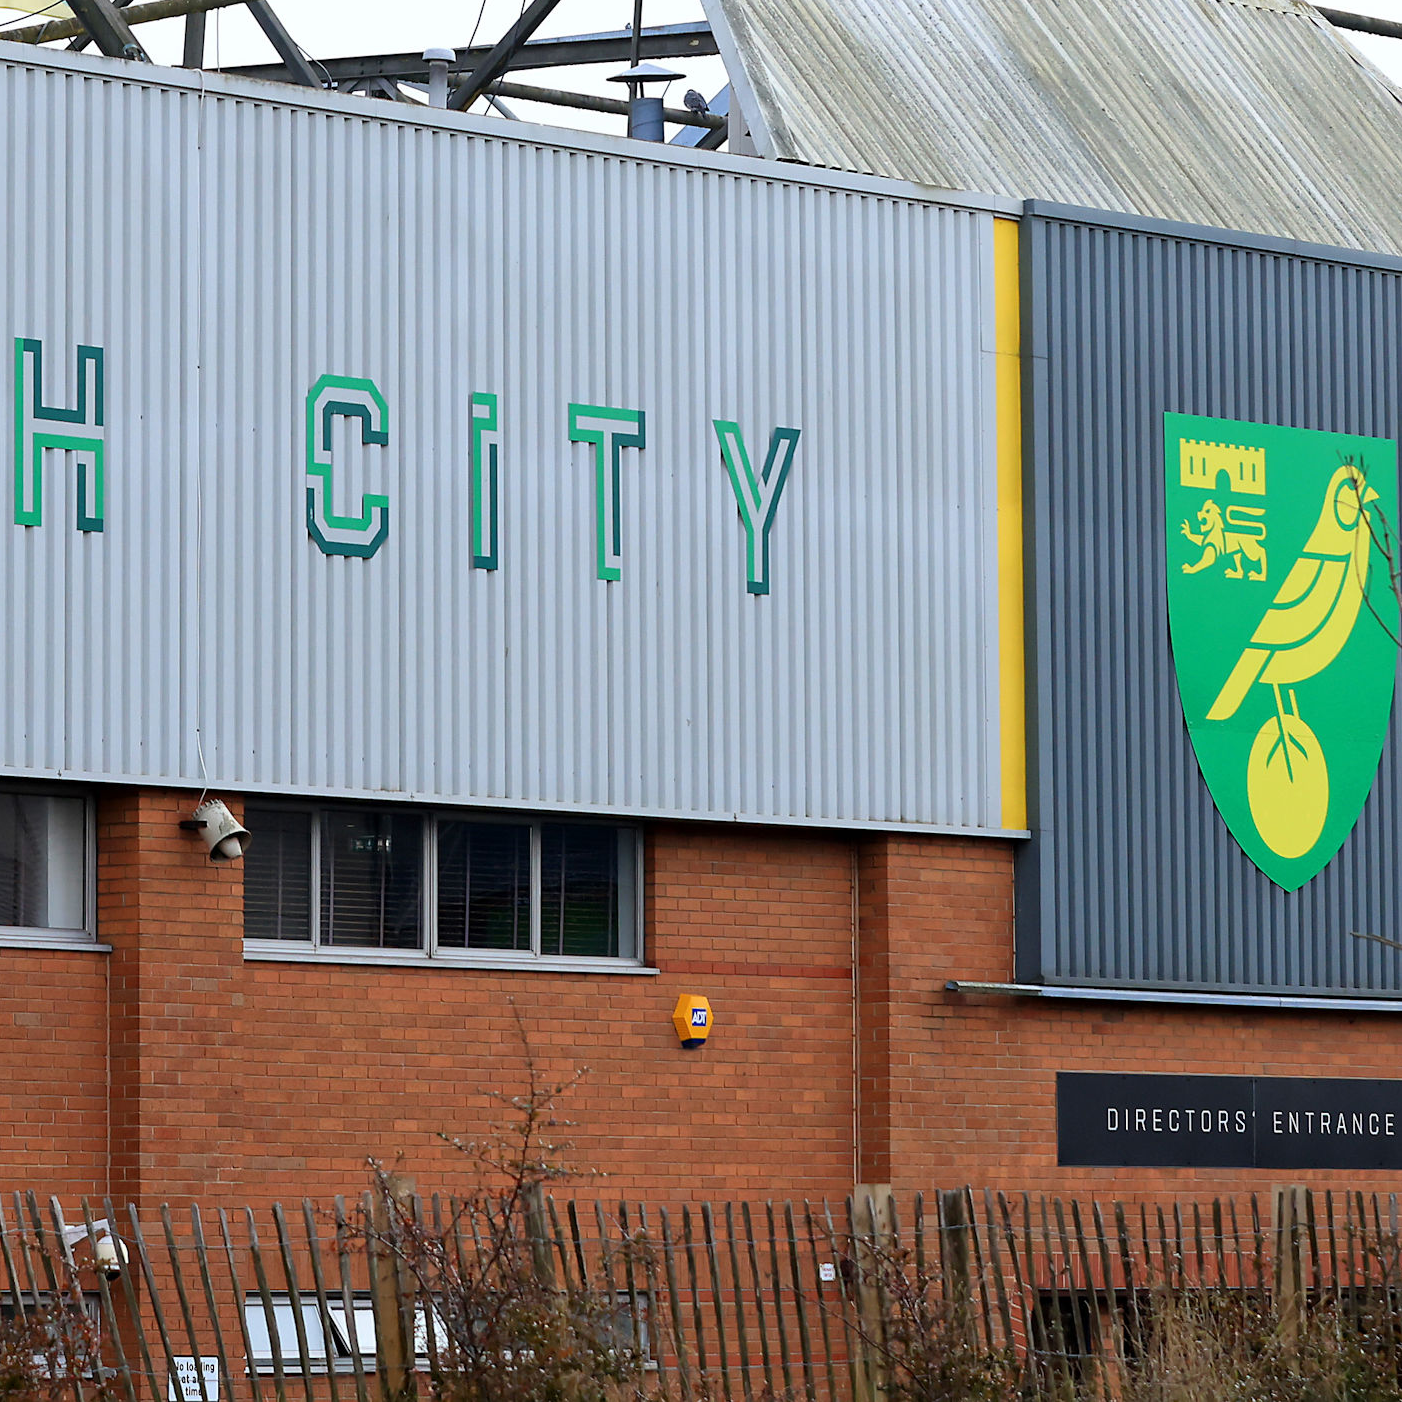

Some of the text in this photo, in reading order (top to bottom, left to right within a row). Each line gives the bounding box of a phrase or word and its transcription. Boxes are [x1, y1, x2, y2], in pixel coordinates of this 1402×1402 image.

[306, 374, 801, 595] CITY
[692, 1011, 707, 1025] ADT
[1273, 1111, 1396, 1136] ENTRANCE
[186, 1361, 215, 1374] loing
